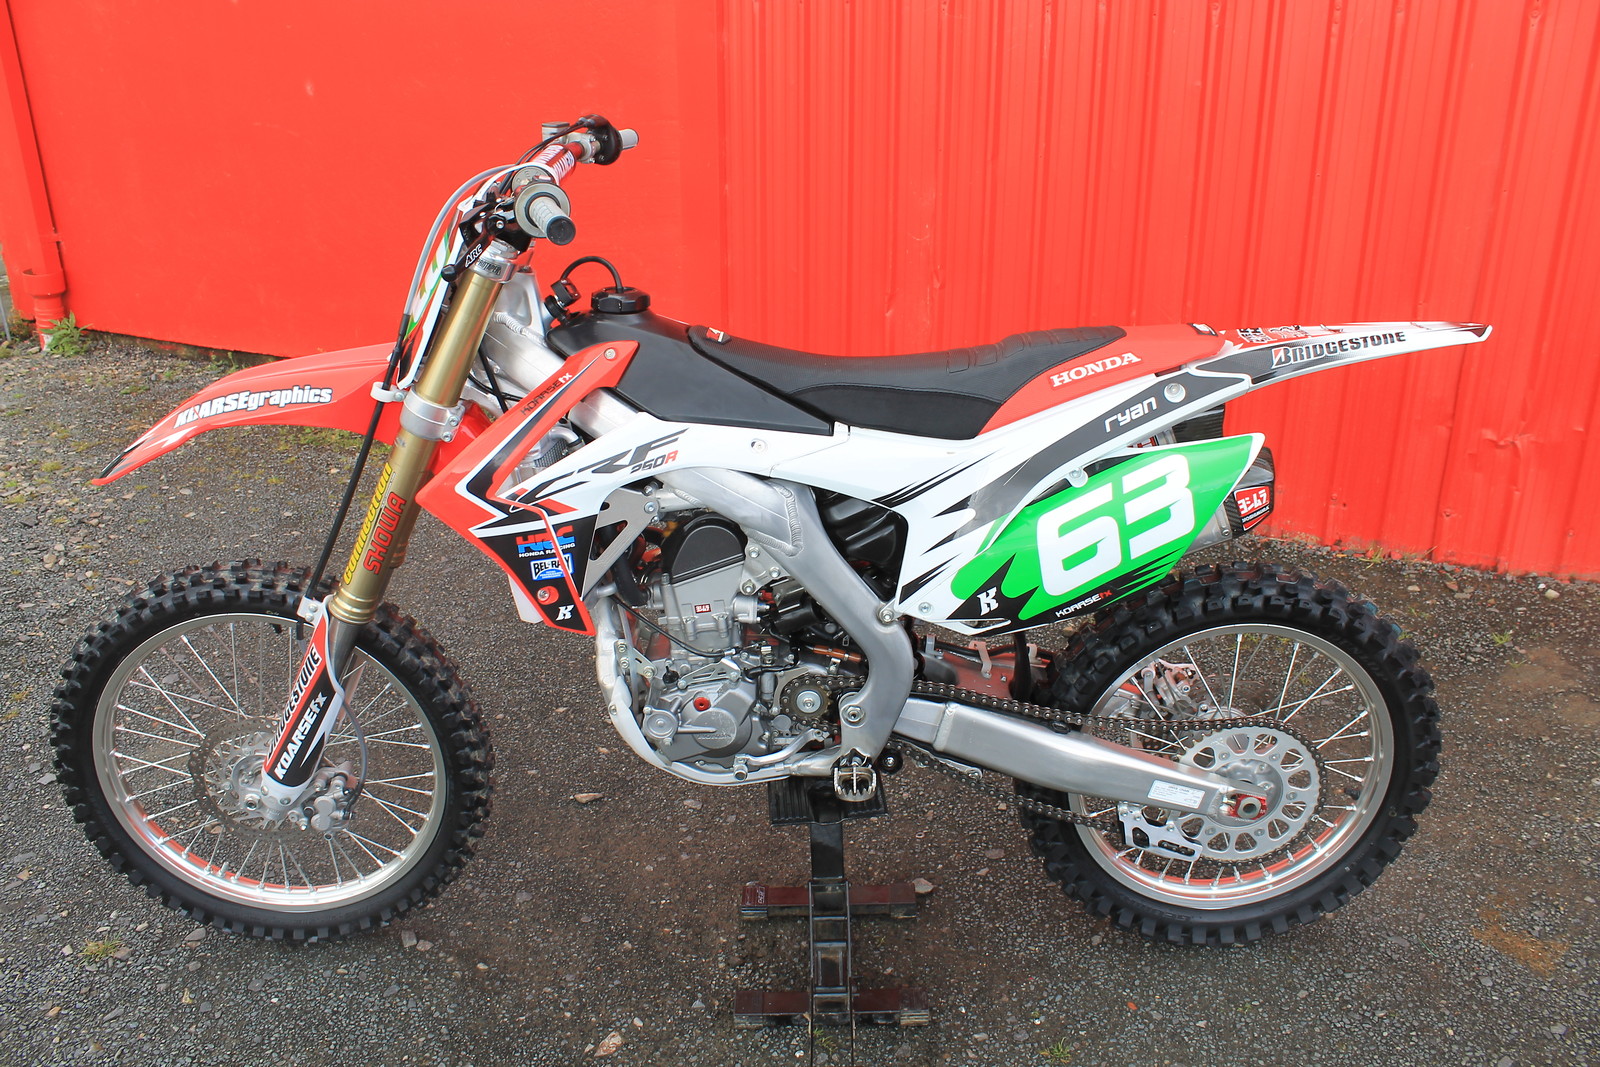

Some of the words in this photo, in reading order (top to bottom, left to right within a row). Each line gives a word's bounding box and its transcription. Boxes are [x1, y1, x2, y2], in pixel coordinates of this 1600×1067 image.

[465, 243, 483, 268] ARC
[1271, 330, 1407, 369] BRIDGESTONE
[1050, 351, 1141, 388] HONDA
[173, 385, 333, 429] KOARSEgraphics
[1105, 396, 1158, 433] ryan
[512, 428, 689, 511] CRF
[629, 450, 679, 475] 250R
[362, 491, 407, 576] SHOWA
[1036, 453, 1196, 597] 63
[518, 550, 545, 558] HONDA
